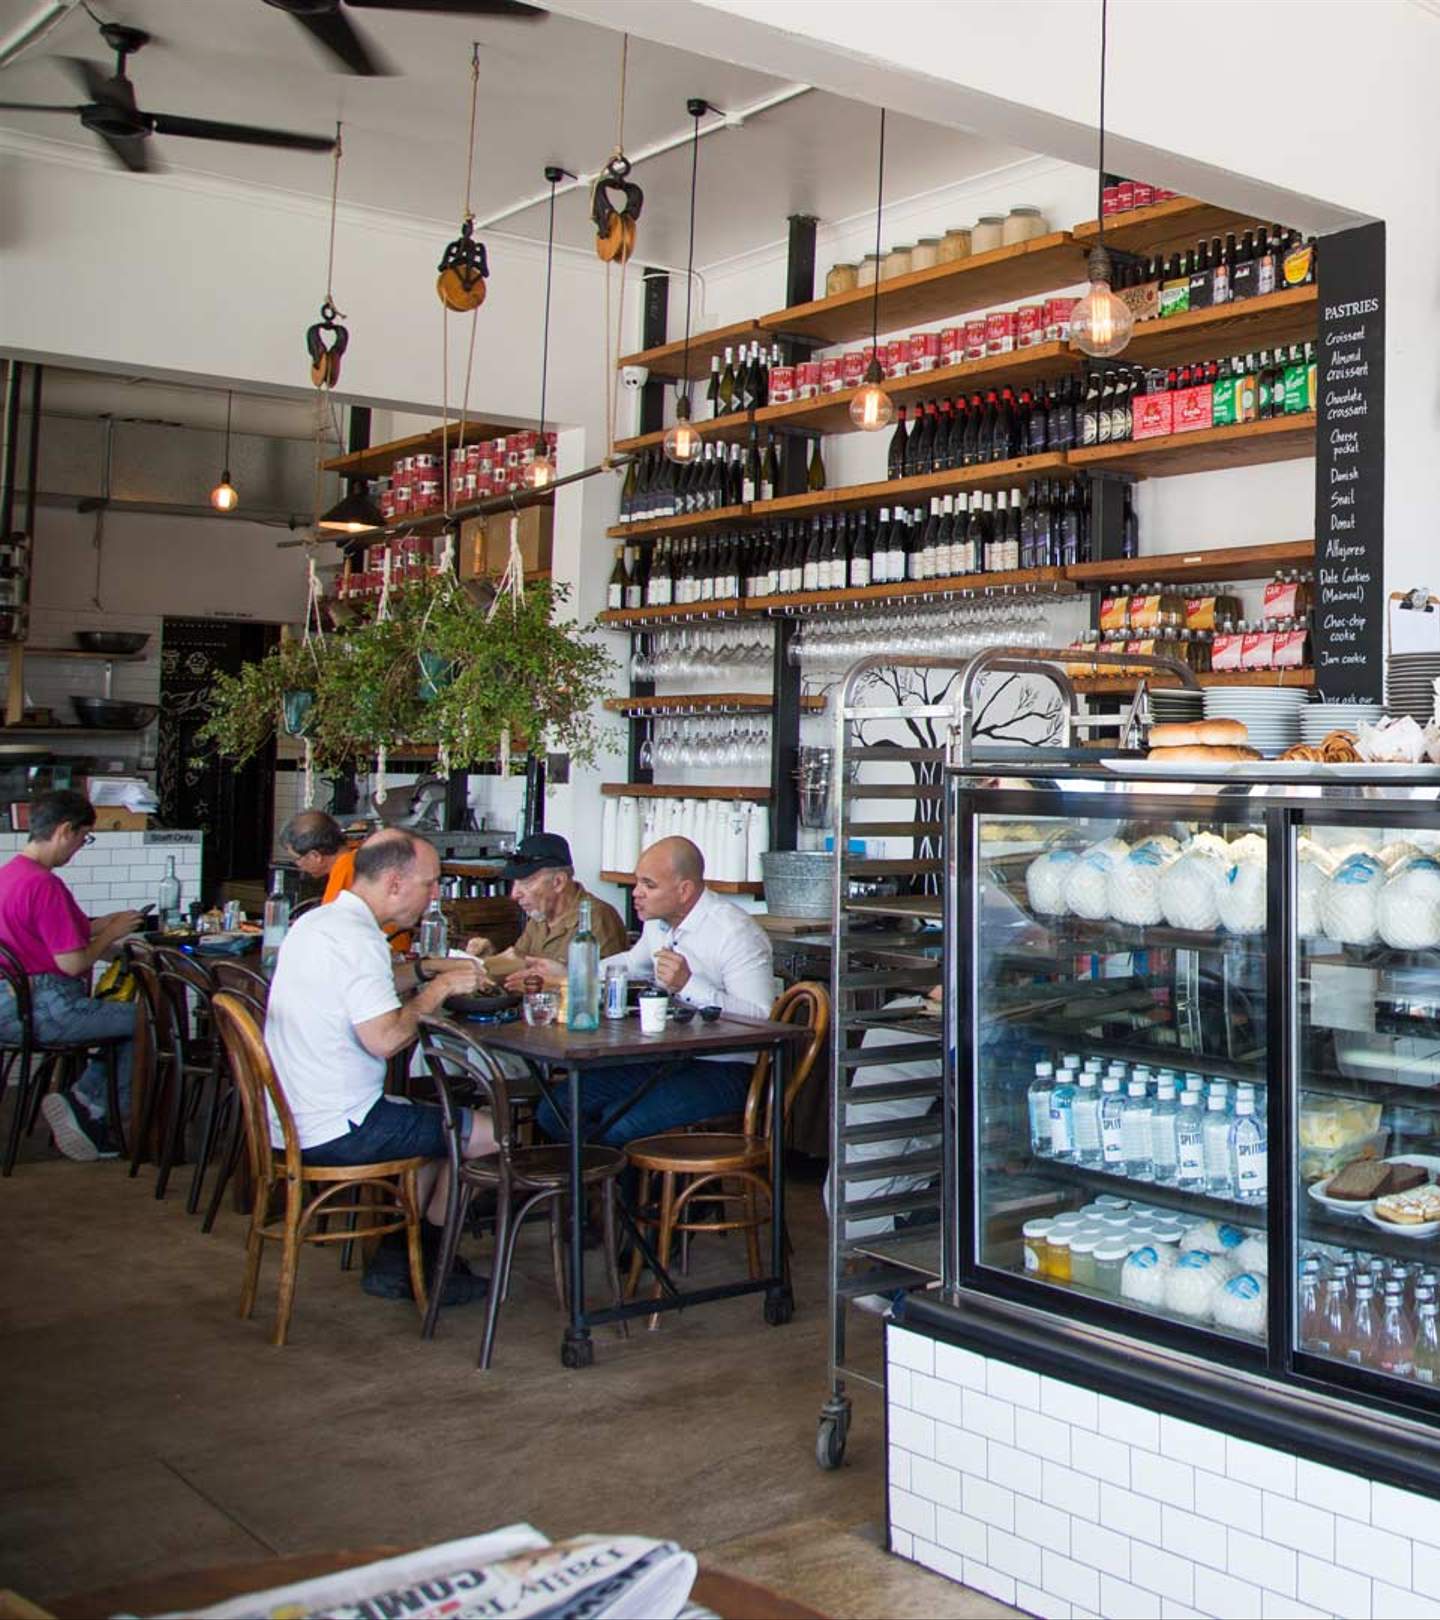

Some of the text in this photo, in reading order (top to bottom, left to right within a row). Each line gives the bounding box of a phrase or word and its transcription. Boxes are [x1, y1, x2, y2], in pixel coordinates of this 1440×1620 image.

[1325, 298, 1380, 321] PASTRIES
[1327, 400, 1369, 420] croissant
[1331, 466, 1360, 484] Danish
[1331, 488, 1355, 508] Snail
[1331, 513, 1356, 530] Donut
[1320, 568, 1339, 585] Date
[1330, 629, 1356, 642] cookie
[1320, 651, 1367, 666] Jam cookie
[1103, 1118, 1121, 1131] SPLIT
[1180, 1133, 1200, 1146] SPLIT
[519, 1546, 625, 1600] Daily
